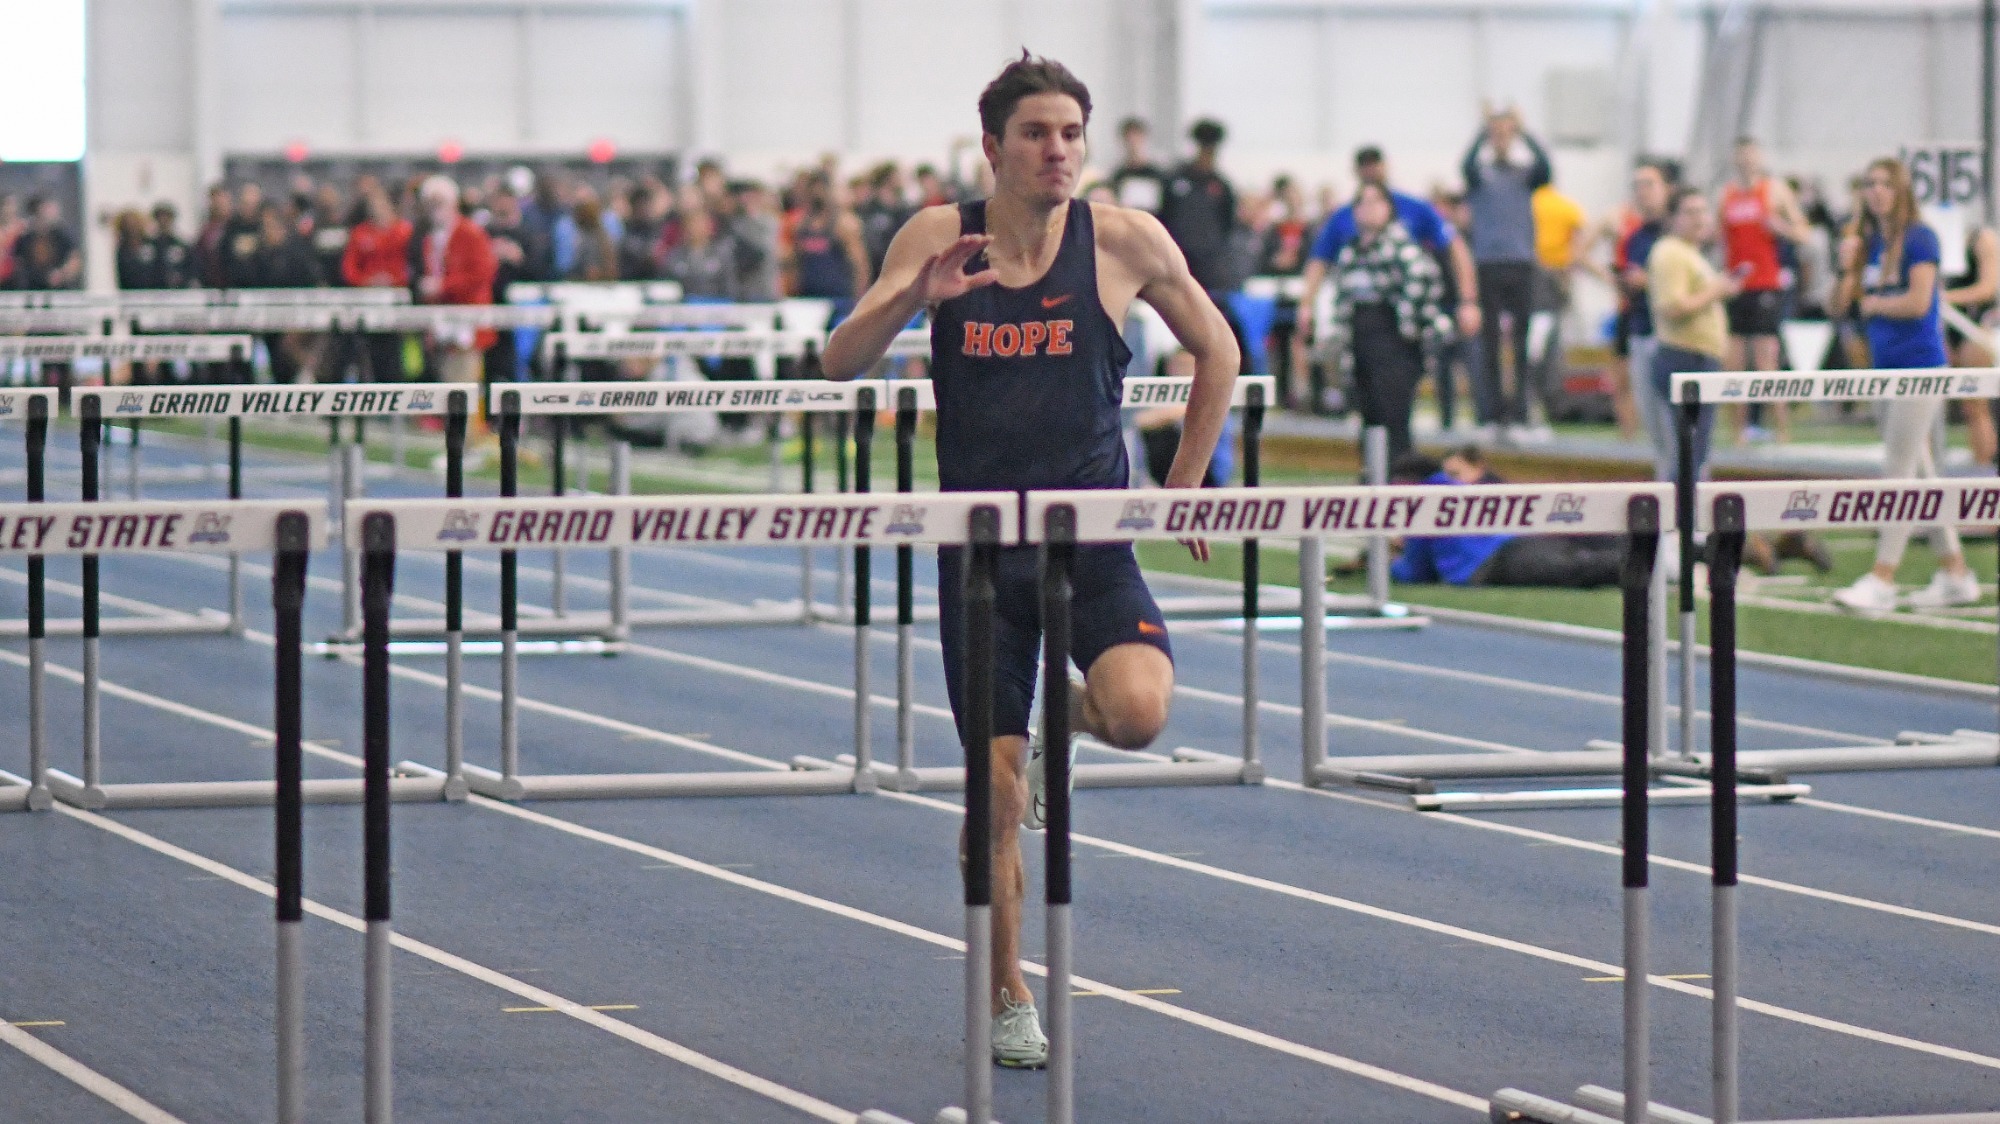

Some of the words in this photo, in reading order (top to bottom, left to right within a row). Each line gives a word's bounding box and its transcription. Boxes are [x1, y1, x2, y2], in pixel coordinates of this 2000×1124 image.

[962, 319, 1073, 357] HOPE
[149, 392, 230, 413] GRAND
[240, 391, 324, 413] VALLEY
[331, 390, 404, 412] STATE
[599, 390, 657, 408] GRAND
[665, 389, 724, 407] VALLEY
[730, 388, 784, 406] STATE
[1748, 378, 1814, 398] GRAND
[1823, 377, 1889, 397] VALLEY
[1895, 376, 1954, 395] STATE
[1164, 498, 1286, 531] GRAND
[1302, 496, 1424, 530] VALLEY
[1434, 494, 1541, 528] STATE
[1827, 488, 1944, 522] GRAND
[67, 513, 183, 548] STATE
[488, 509, 614, 543] GRAND
[631, 508, 758, 541] VALLEY
[768, 505, 879, 540] STATE
